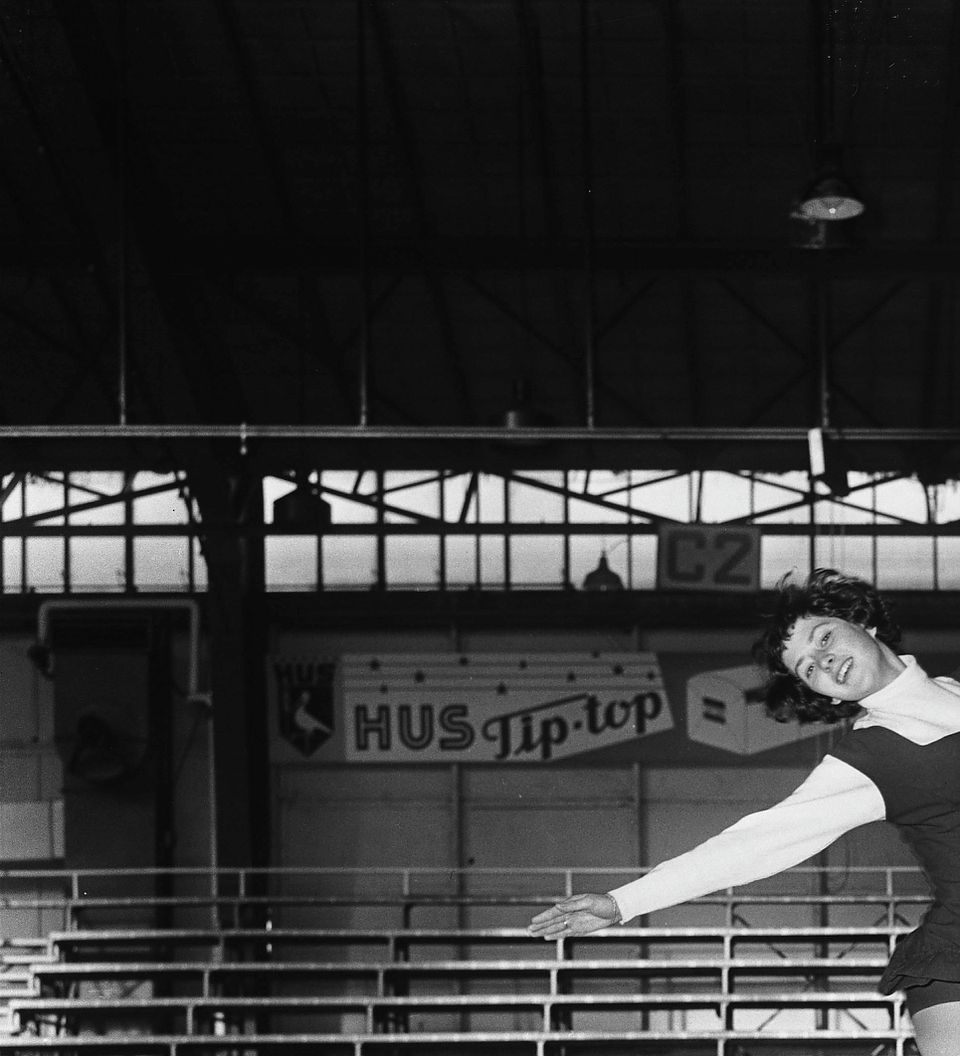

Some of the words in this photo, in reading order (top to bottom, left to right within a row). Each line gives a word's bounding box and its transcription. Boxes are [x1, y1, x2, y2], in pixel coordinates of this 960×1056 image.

[666, 531, 753, 584] C2
[273, 661, 335, 682] HUS
[354, 704, 476, 751] HUS
